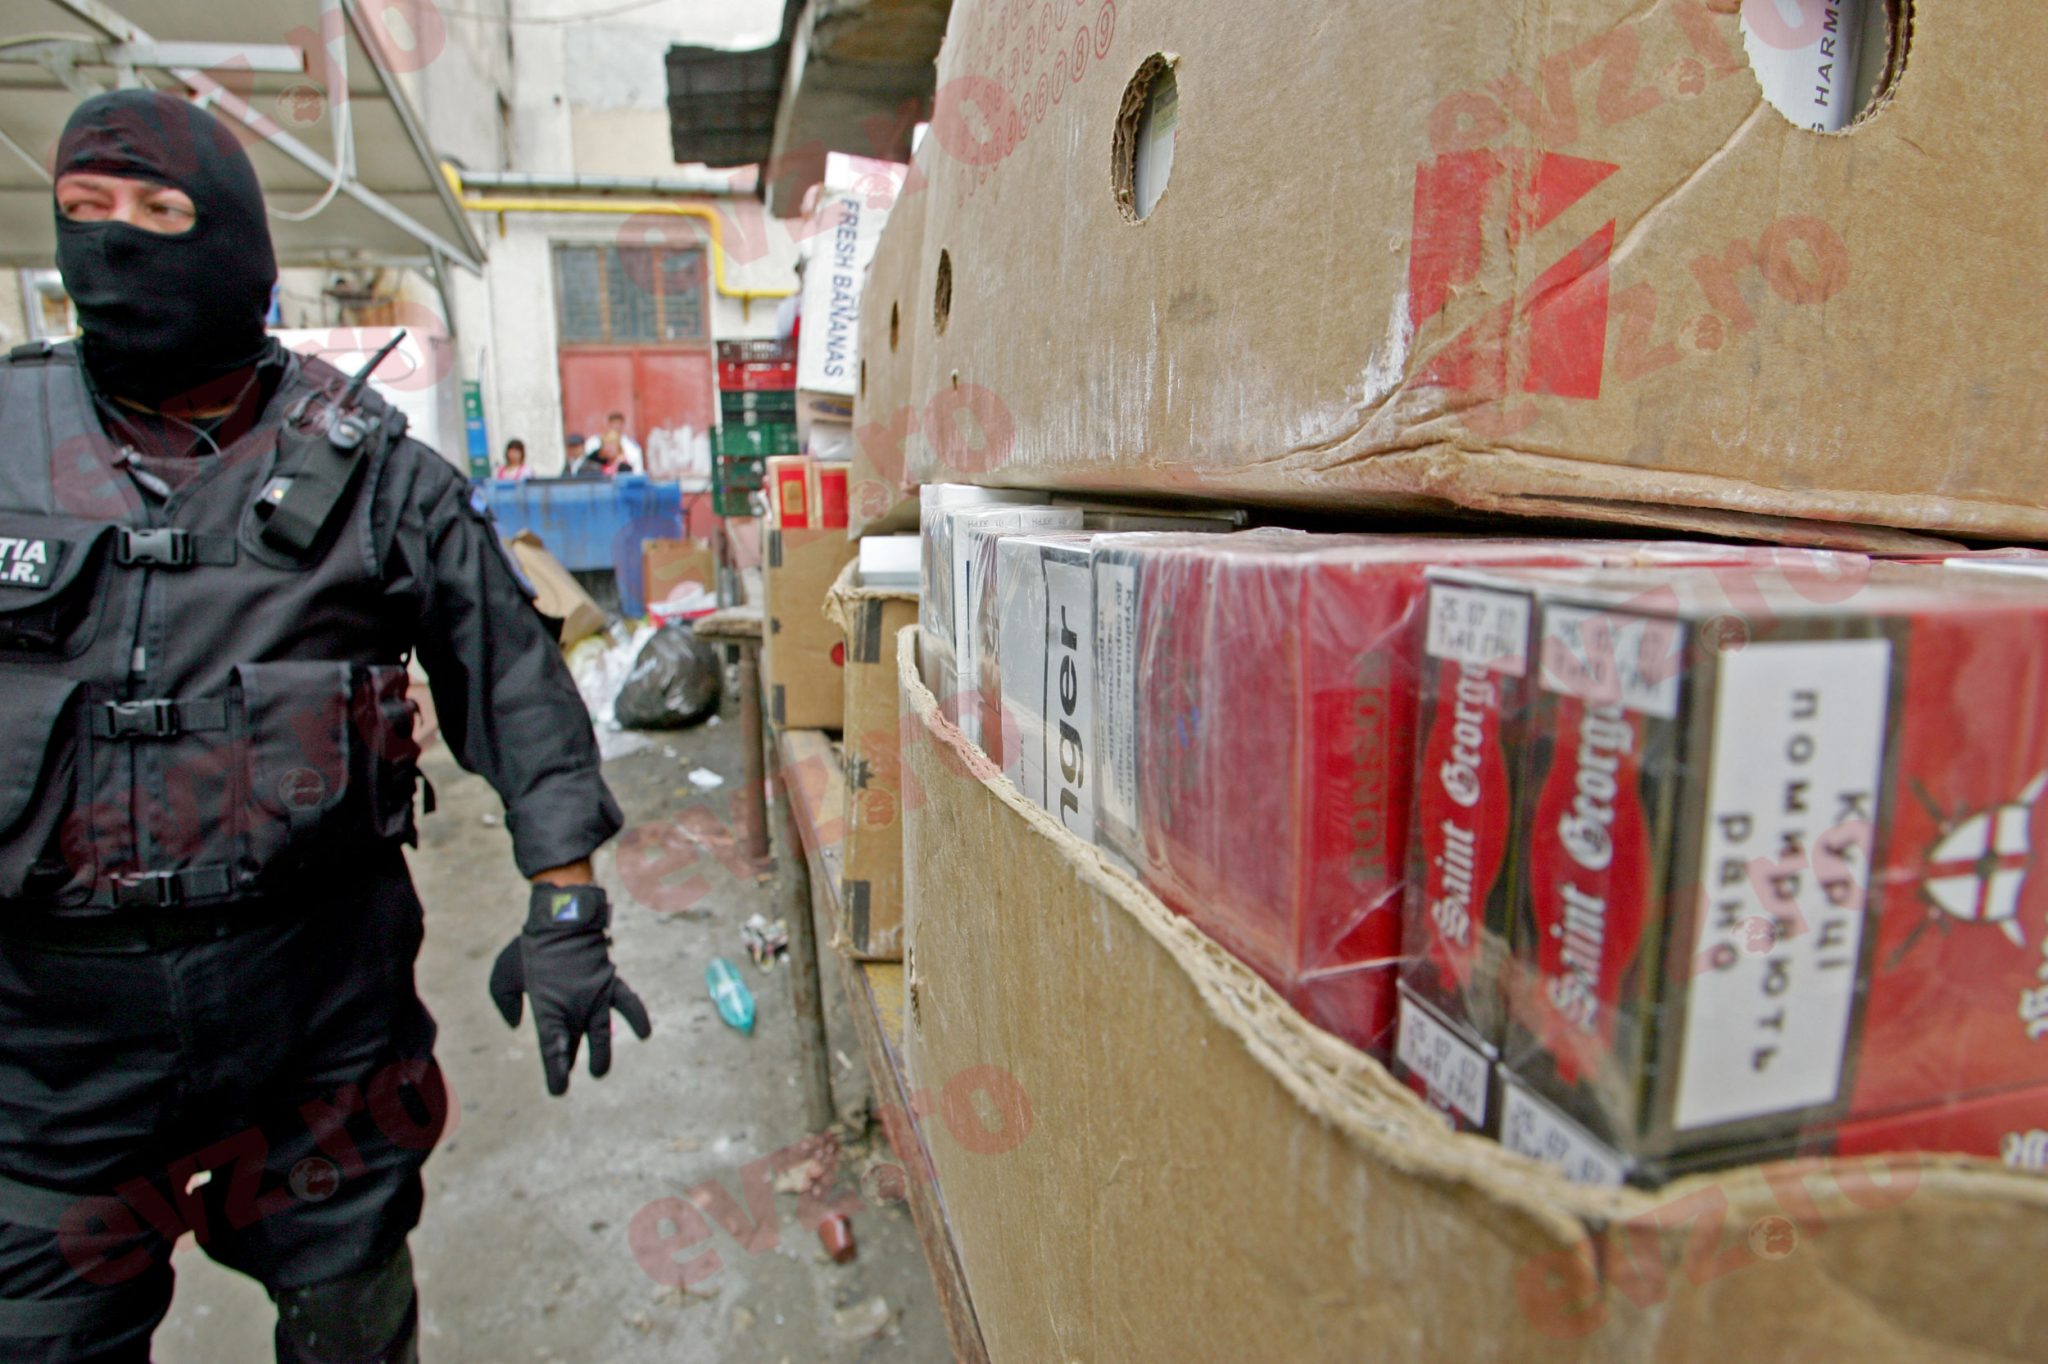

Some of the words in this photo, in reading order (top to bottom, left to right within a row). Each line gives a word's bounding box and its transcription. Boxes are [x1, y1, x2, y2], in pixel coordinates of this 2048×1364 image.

[834, 198, 861, 268] FRESH
[824, 274, 853, 377] BANANAS
[1349, 650, 1386, 881] RONSON
[1431, 818, 1475, 946] Saint
[1544, 881, 1606, 1035] Saint
[1714, 812, 1754, 972] рано
[1749, 688, 1820, 1074] помирають
[1813, 789, 1870, 972] Курці
